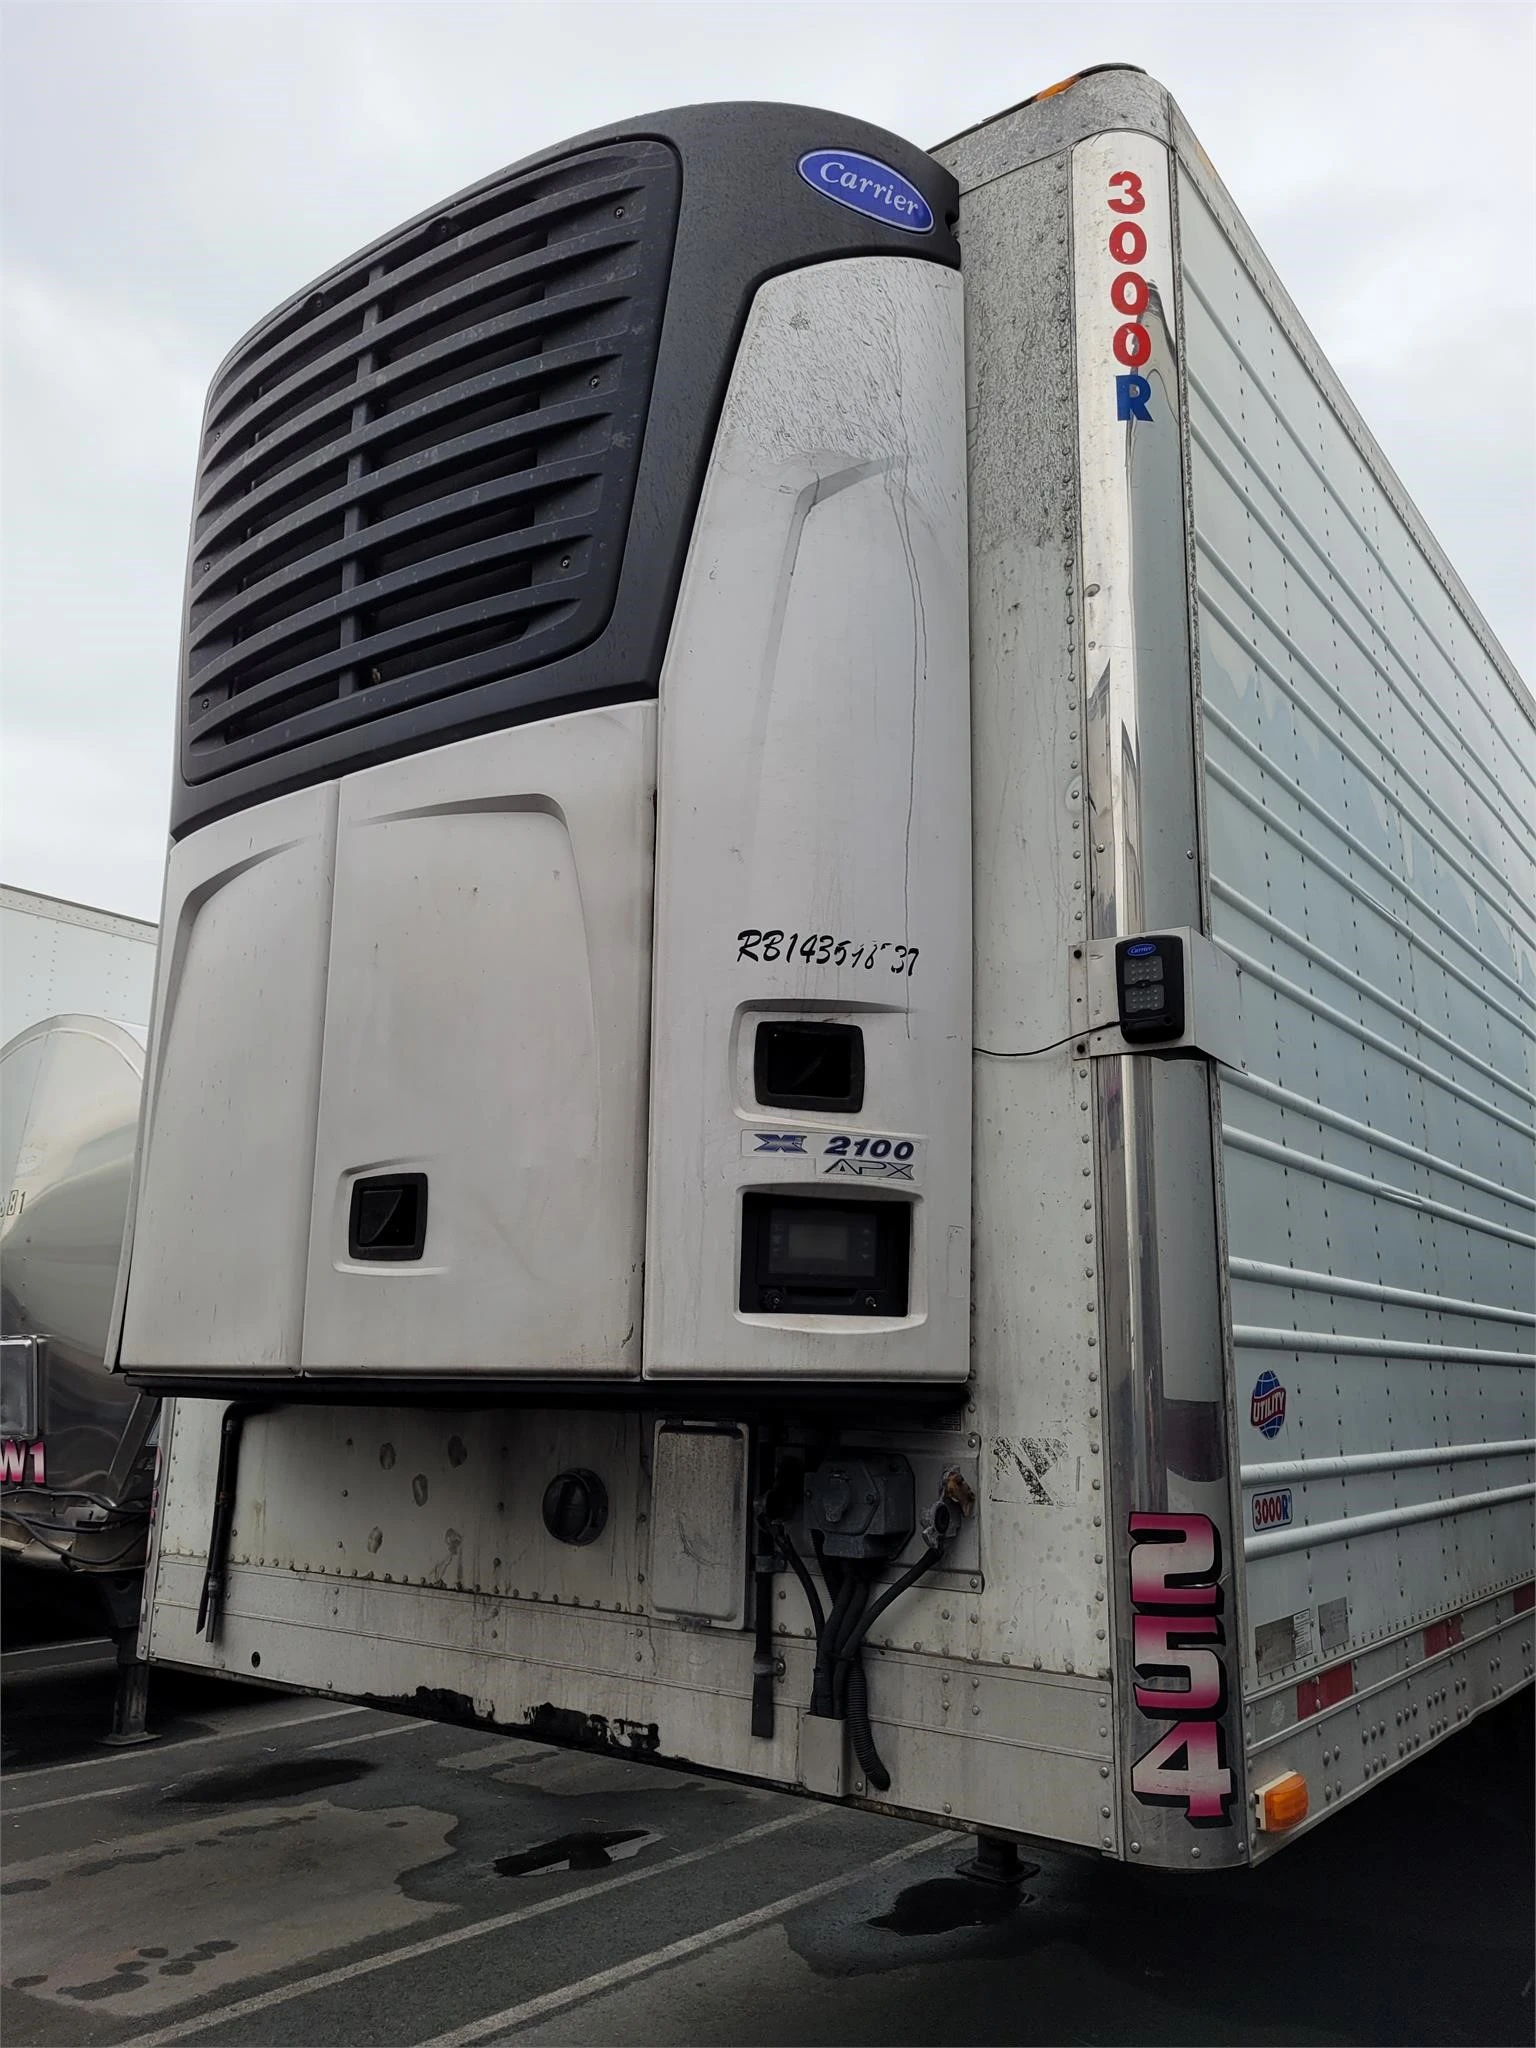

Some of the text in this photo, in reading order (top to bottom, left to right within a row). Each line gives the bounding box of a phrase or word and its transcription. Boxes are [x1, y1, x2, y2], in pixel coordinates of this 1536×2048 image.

[820, 161, 919, 216] Carrier
[1106, 170, 1154, 422] 3000R
[1130, 946, 1153, 954] Carrier
[823, 1135, 914, 1161] 2100
[823, 1158, 915, 1181] APX
[1253, 1391, 1285, 1422] UTILITY
[1255, 1494, 1290, 1526] 3000R
[1128, 1511, 1237, 1829] 254
